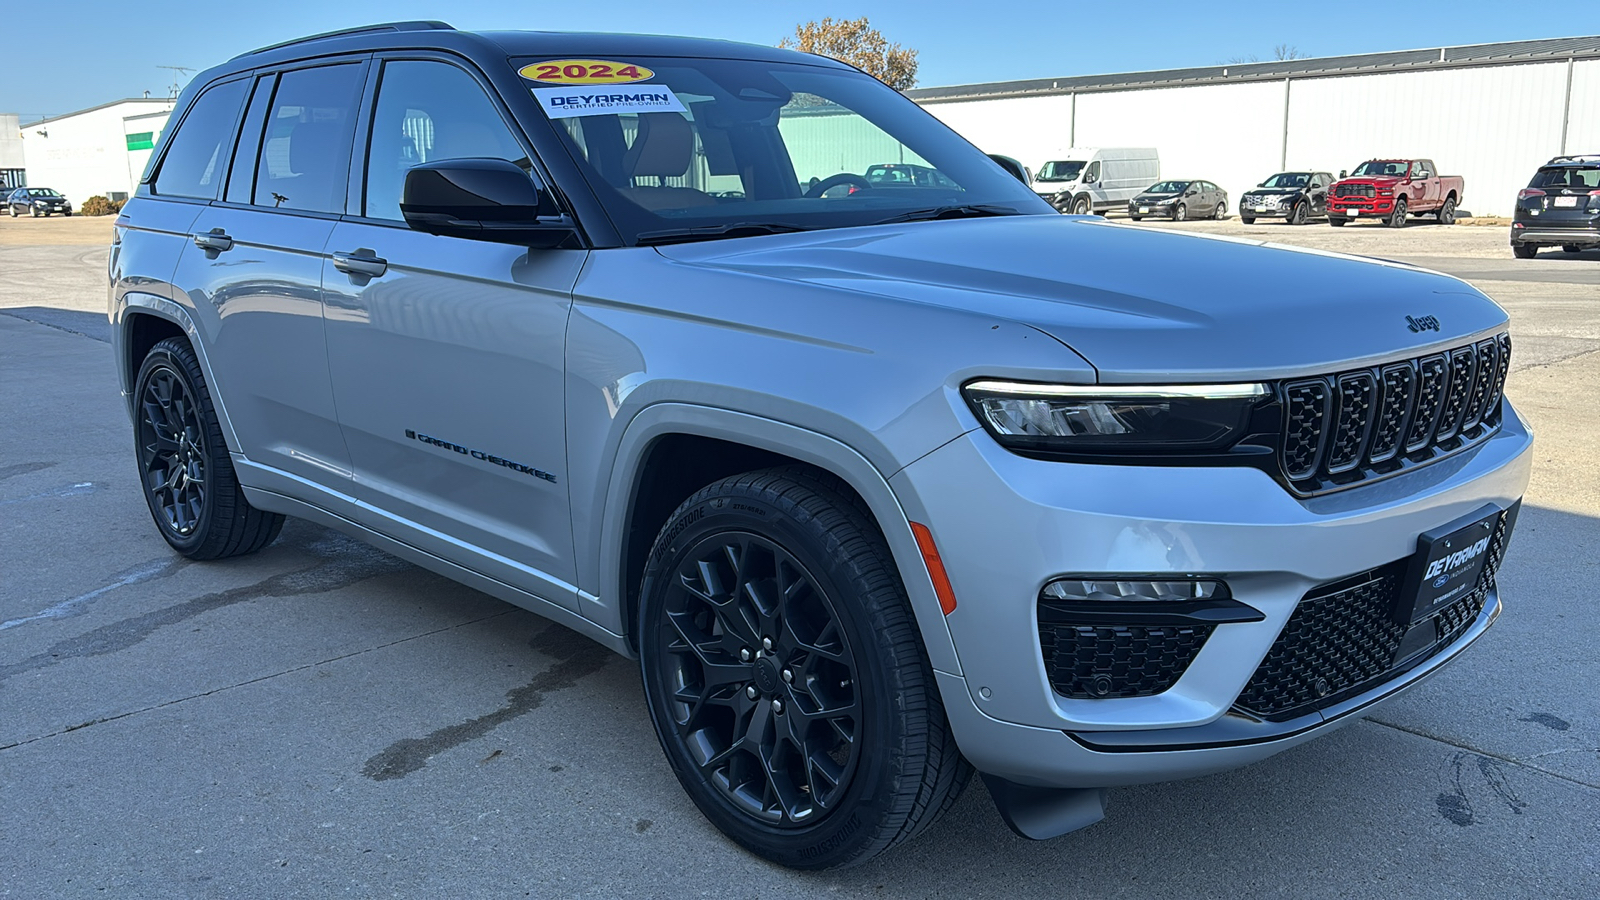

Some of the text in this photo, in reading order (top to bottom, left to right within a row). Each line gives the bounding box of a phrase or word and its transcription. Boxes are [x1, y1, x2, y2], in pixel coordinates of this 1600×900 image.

[536, 64, 643, 79] 2024
[550, 93, 669, 106] DEYARMAN
[562, 102, 613, 110] CERTIFIED
[1405, 314, 1440, 333] Jeep
[417, 432, 557, 484] GRAND CHEROKEE
[654, 506, 705, 563] BRIDGESTONE
[1424, 534, 1492, 581] DEYARMAN
[796, 811, 862, 860] BRIDGESTONE
